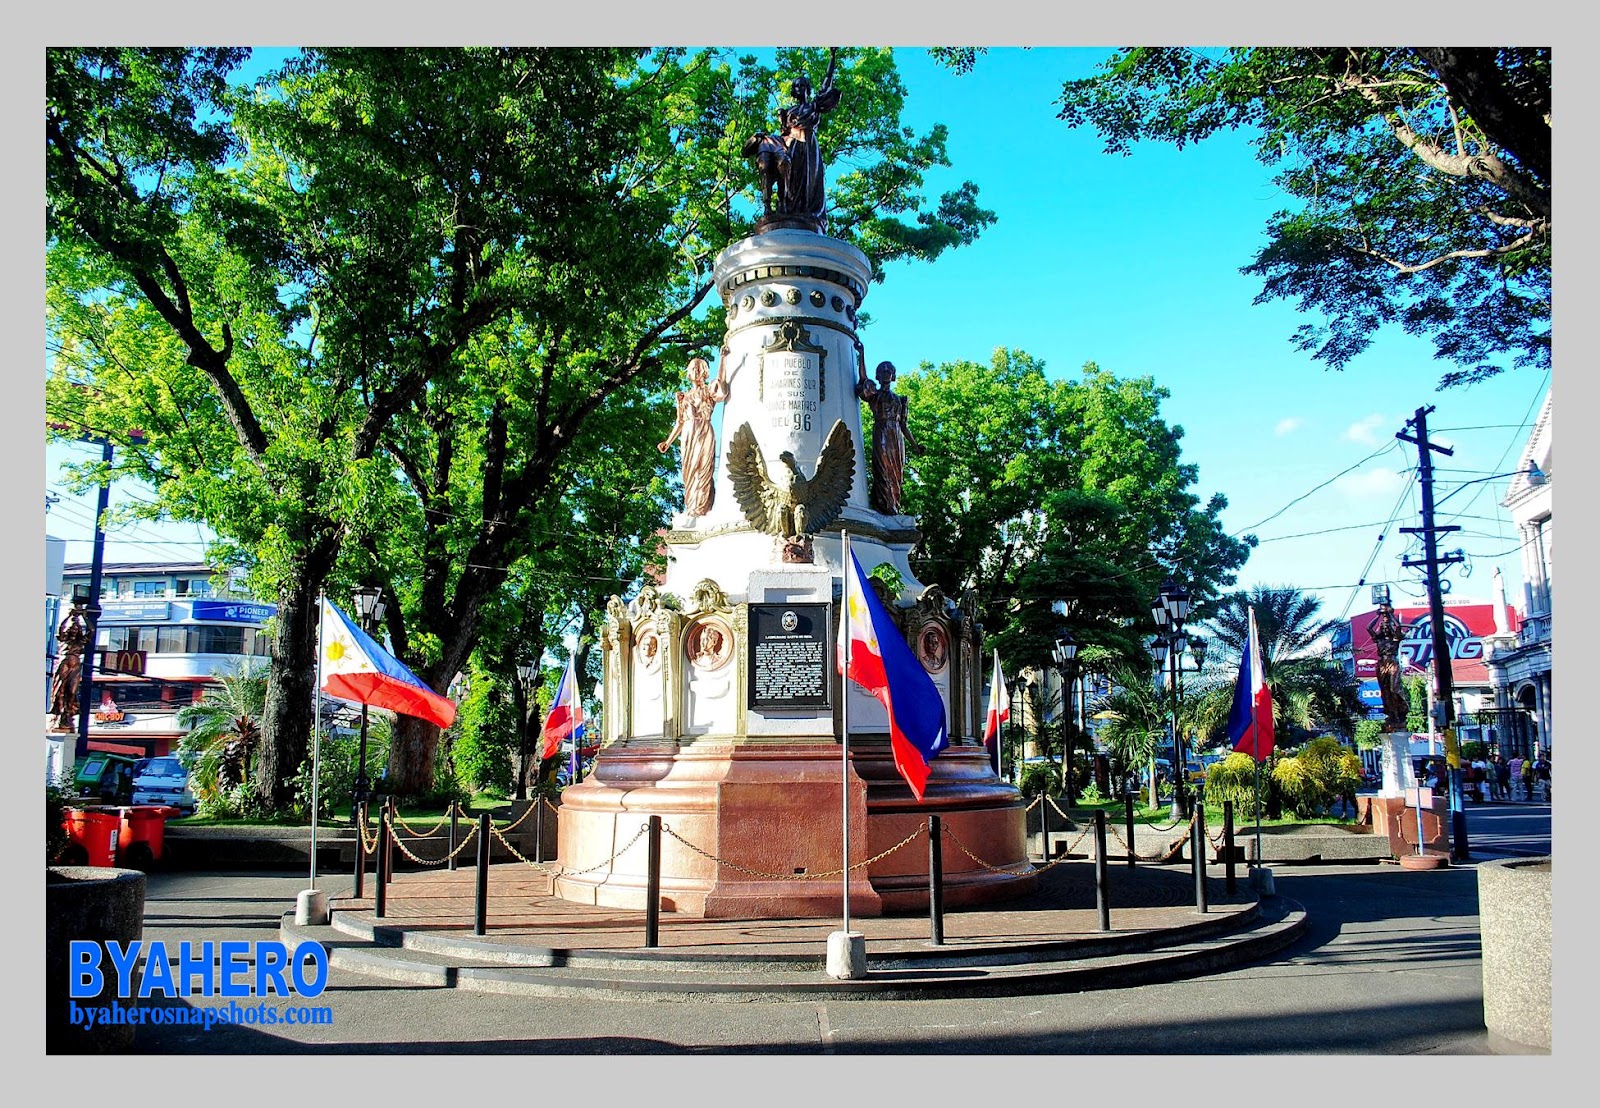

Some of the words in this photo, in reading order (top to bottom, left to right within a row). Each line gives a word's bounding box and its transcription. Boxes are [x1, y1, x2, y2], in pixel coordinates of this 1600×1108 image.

[784, 358, 811, 370] PUEBLO
[804, 378, 817, 390] SUR
[788, 400, 817, 412] MARTIRES
[793, 413, 811, 432] 96
[239, 606, 269, 617] PIONEER
[1399, 637, 1483, 665] STNG
[95, 712, 124, 721] CHIC-BOY
